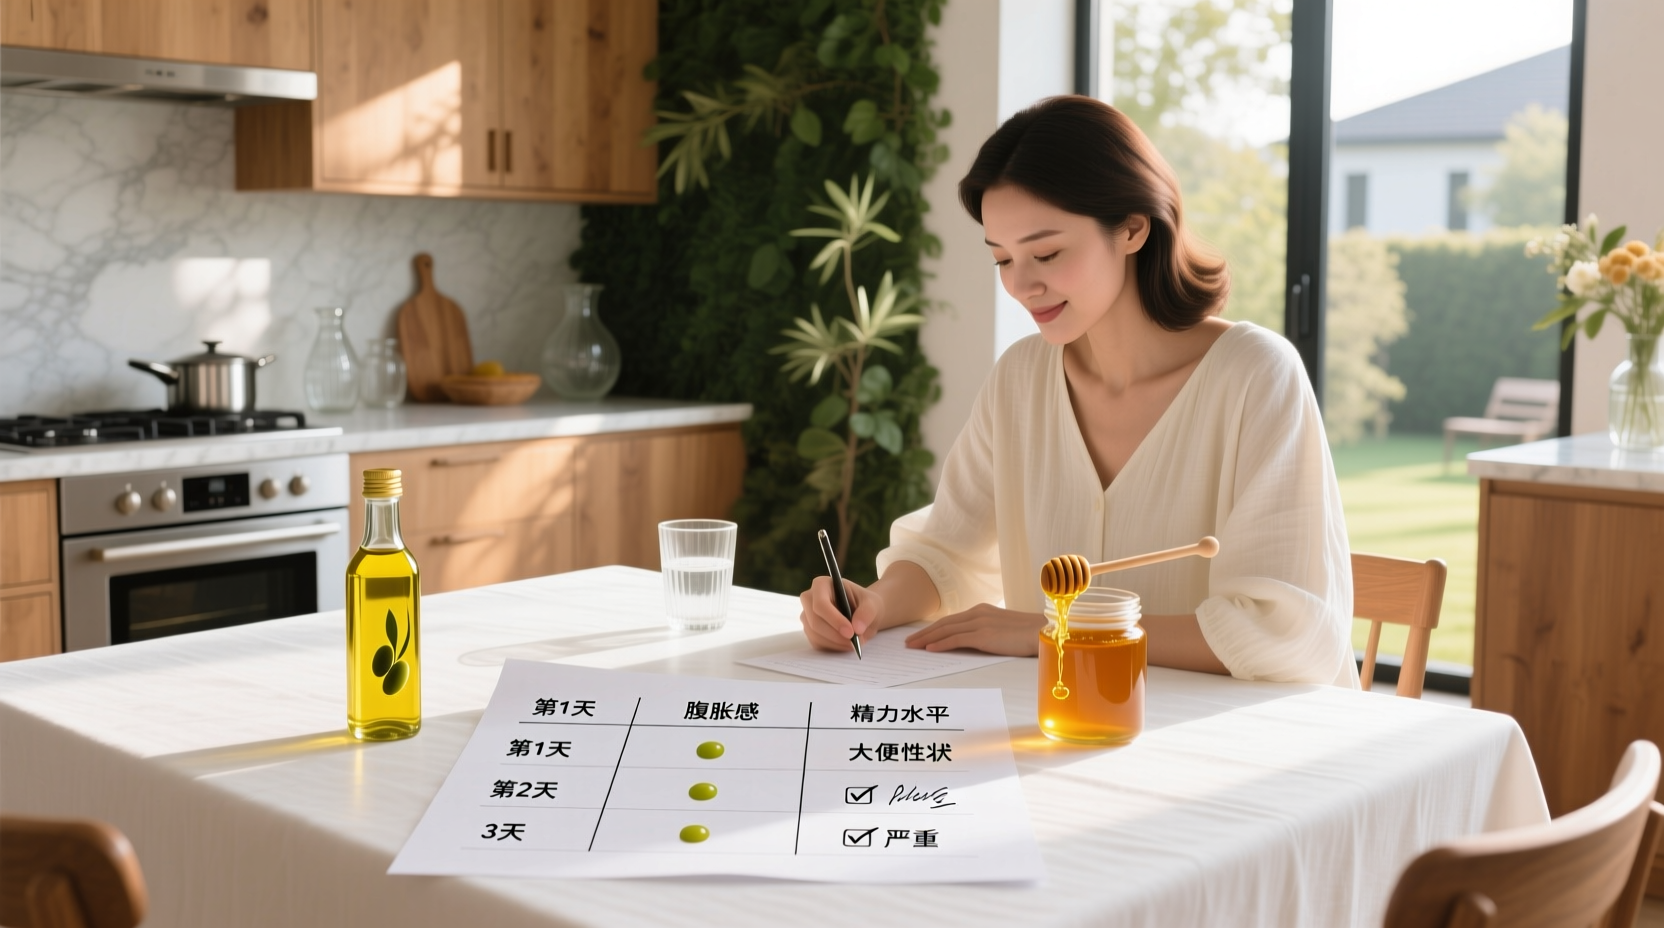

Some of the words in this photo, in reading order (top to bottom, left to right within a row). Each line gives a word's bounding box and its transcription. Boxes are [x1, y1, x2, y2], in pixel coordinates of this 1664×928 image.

[531, 697, 597, 718] 第1天
[683, 700, 760, 721] 腹胀感
[850, 703, 950, 724] 精力水平
[506, 738, 573, 759] 第1天
[848, 741, 953, 763] 大便性状
[489, 779, 560, 800] 第2天
[480, 822, 527, 843] 3天
[884, 828, 939, 849] 严重
